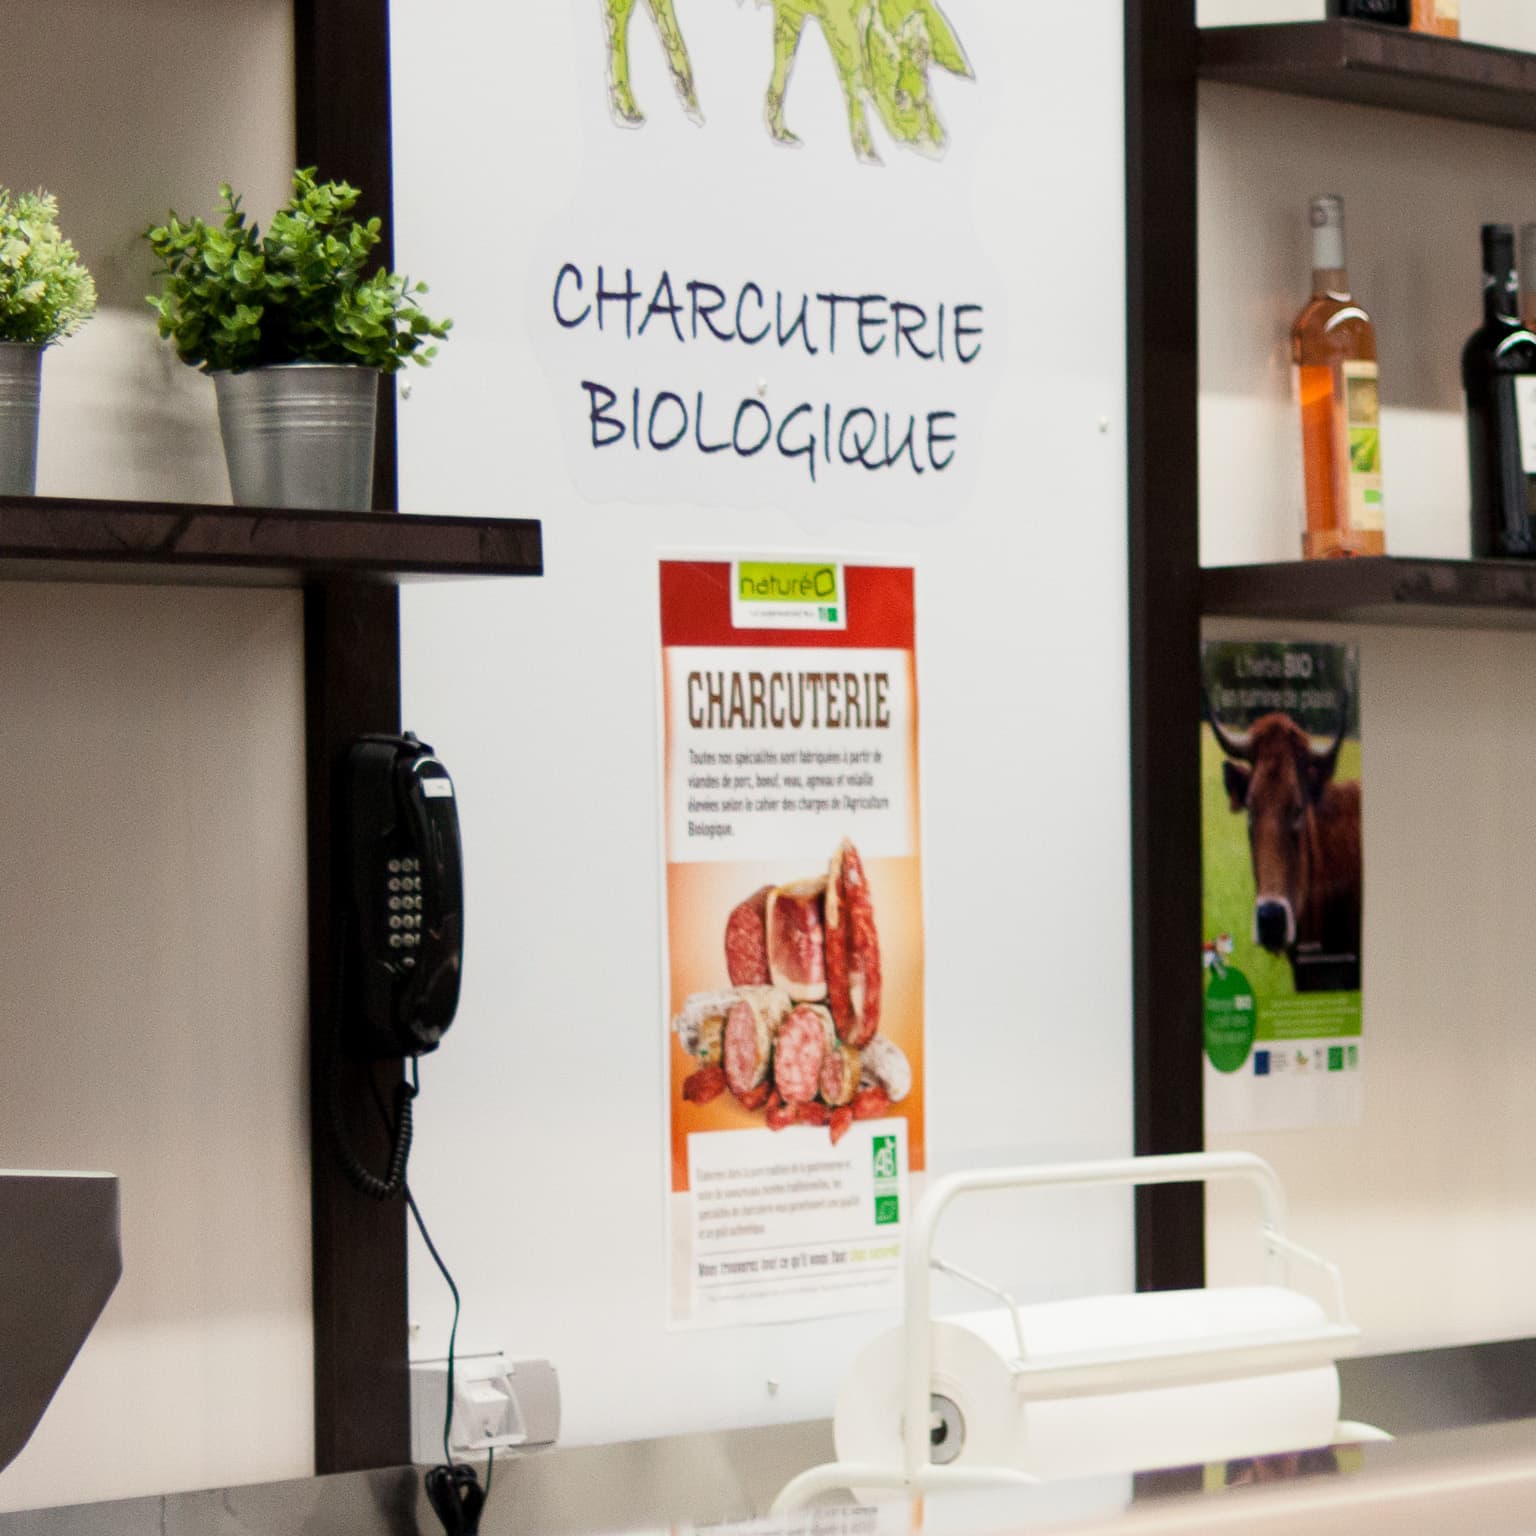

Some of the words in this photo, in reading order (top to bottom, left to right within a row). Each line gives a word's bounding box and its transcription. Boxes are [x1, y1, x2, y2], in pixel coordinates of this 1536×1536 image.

[552, 263, 983, 364] CHARCUTERIE
[580, 380, 957, 483] BIOLOGIQUE
[687, 671, 890, 729] CHARCUTERIE
